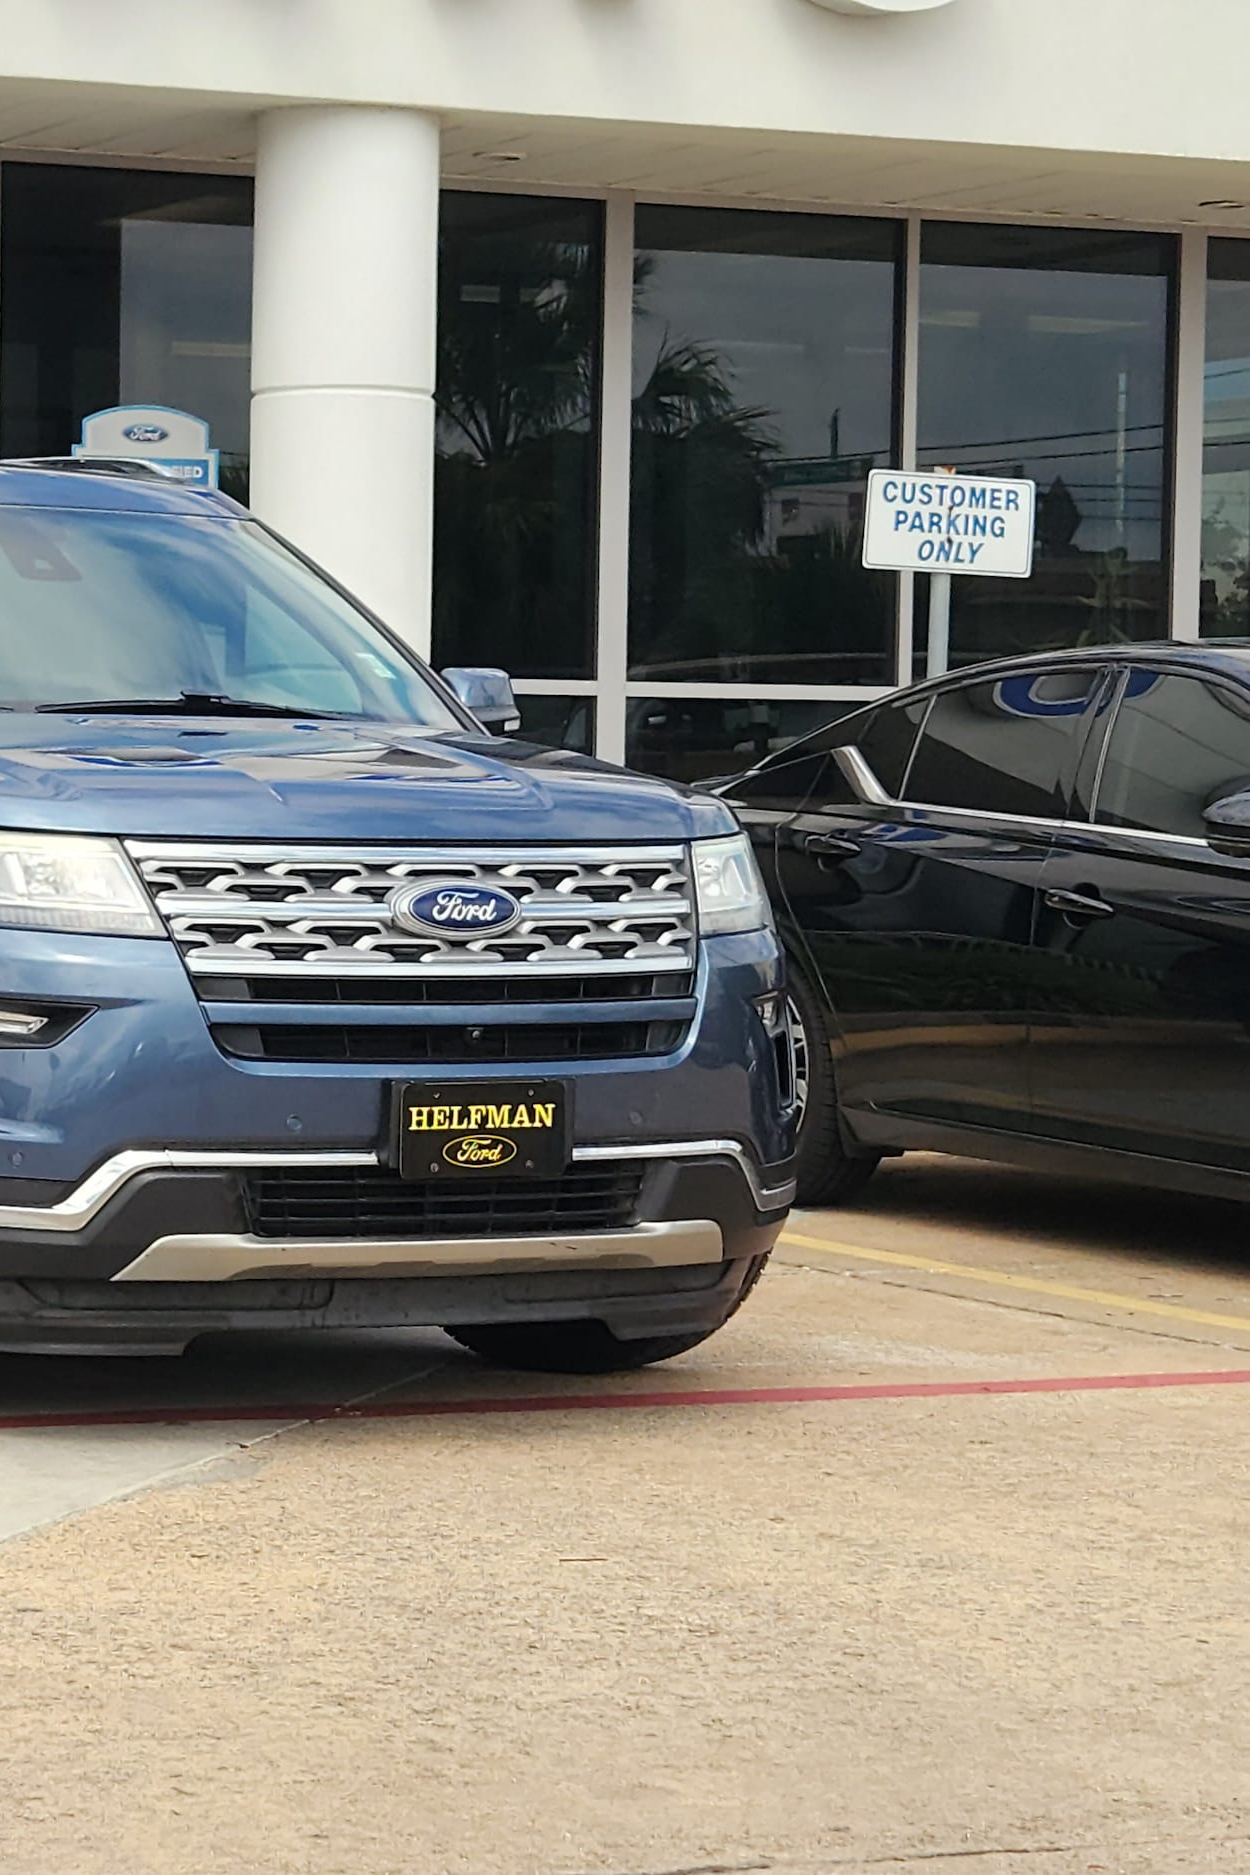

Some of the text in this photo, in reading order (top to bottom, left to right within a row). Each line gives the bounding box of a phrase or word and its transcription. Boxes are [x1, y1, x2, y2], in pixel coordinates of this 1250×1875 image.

[130, 426, 161, 441] Ford
[883, 481, 1020, 511] CUSTOMER
[894, 510, 1006, 538] PARKING
[918, 540, 985, 564] ONLY
[431, 890, 498, 922] Ford
[408, 1103, 556, 1131] HELFMAN
[456, 1139, 502, 1162] Ford
